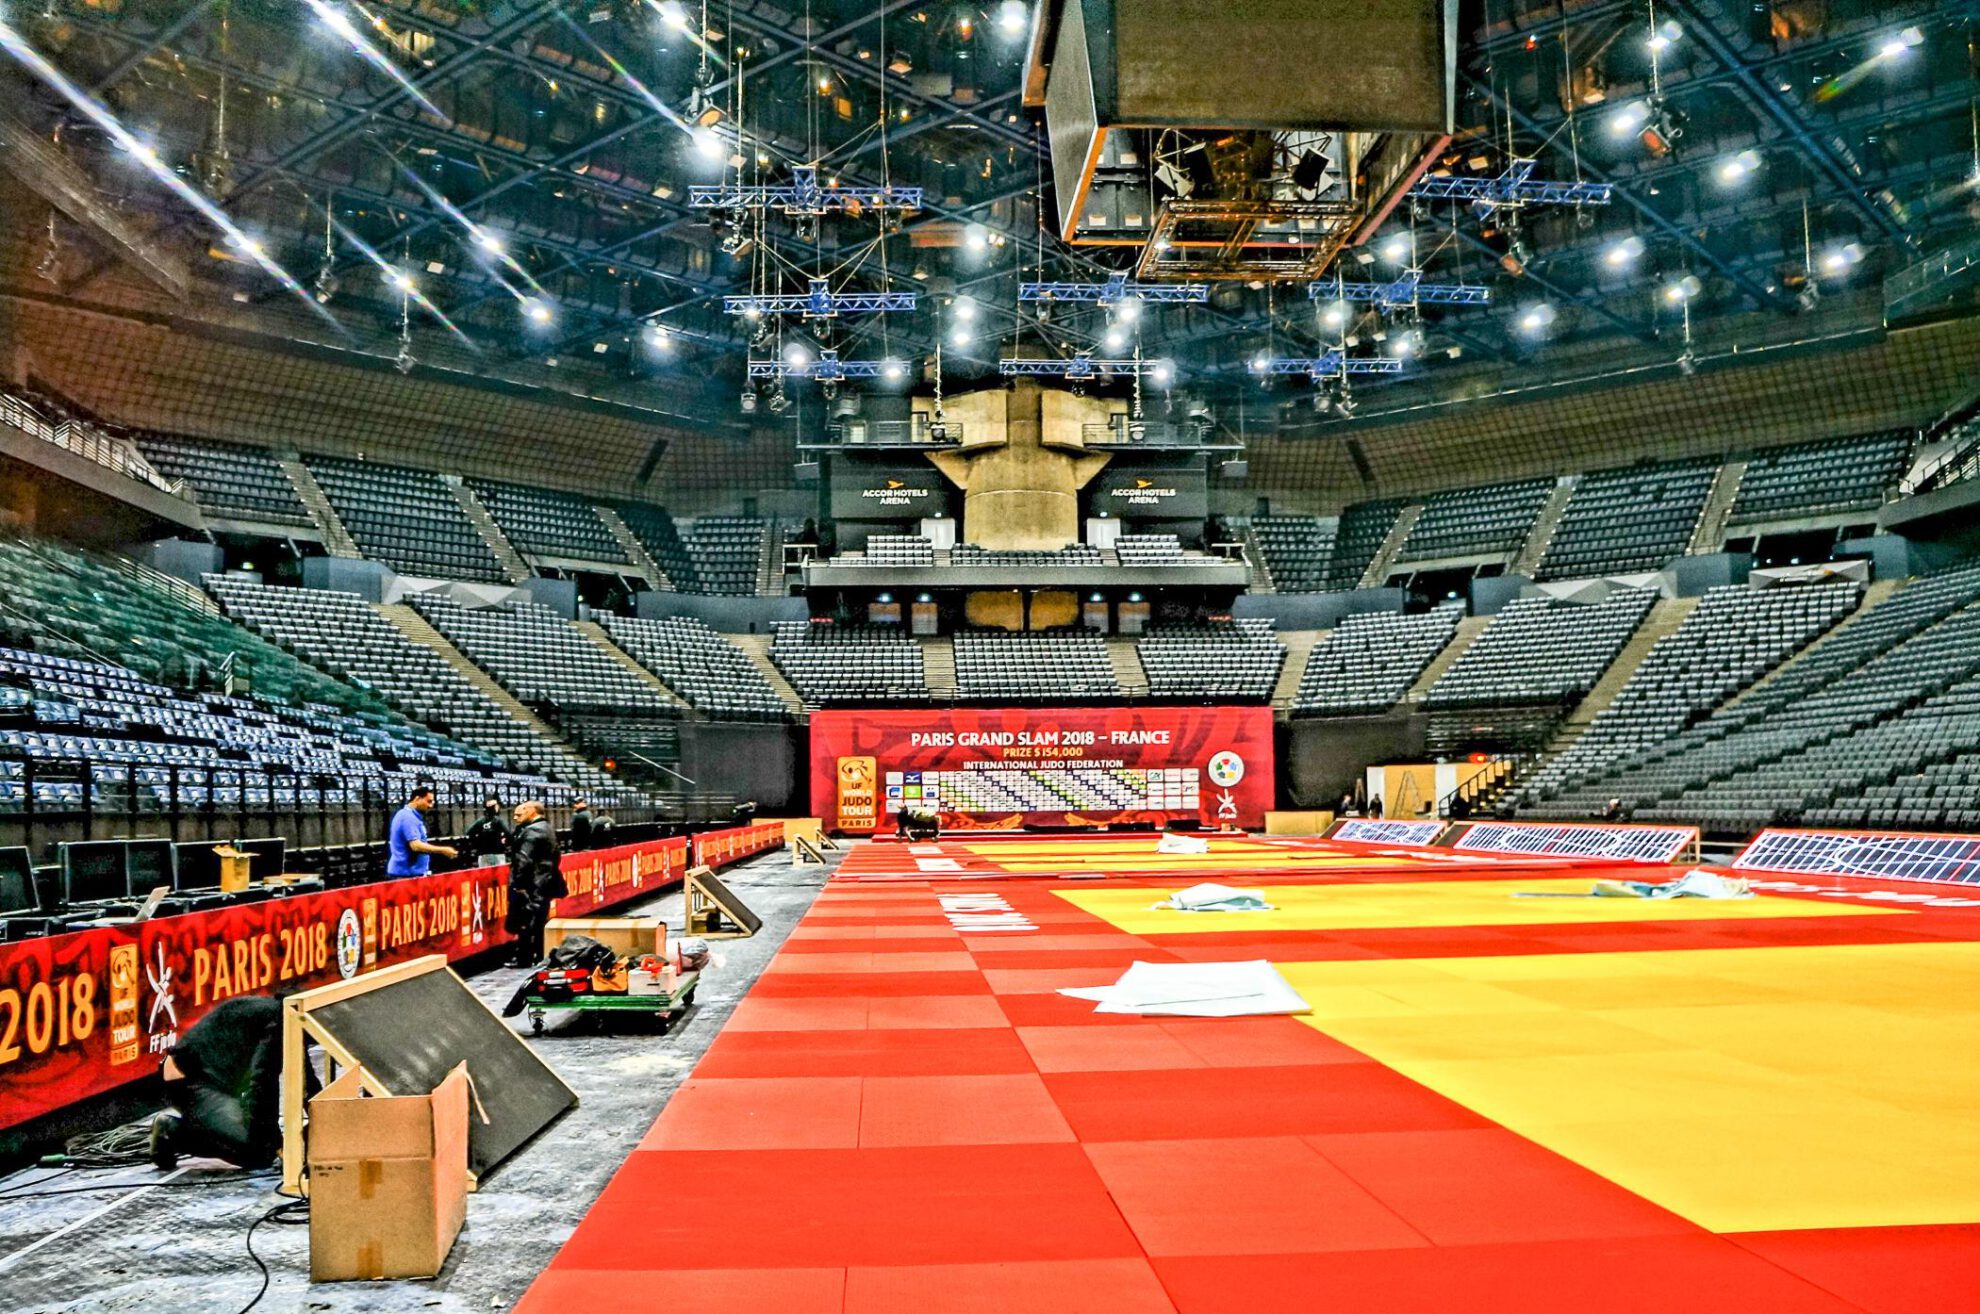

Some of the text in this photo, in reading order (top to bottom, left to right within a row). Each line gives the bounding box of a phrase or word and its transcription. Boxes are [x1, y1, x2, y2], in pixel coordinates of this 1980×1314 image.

[879, 497, 911, 505] ARENA
[1127, 496, 1159, 504] ARENA
[911, 732, 955, 747] PARIS
[957, 732, 1014, 747] GRAND
[1017, 731, 1059, 746] SLAM
[1061, 731, 1096, 746] 2018
[1110, 730, 1170, 745] FRANCE
[1003, 747, 1032, 758] PRIZE
[963, 759, 1124, 770] INTERNATIONAL JUDO FEDERATION
[842, 789, 873, 797] WORLD
[842, 796, 873, 806] JUDO
[842, 805, 873, 816] TOUR
[841, 818, 873, 827] PARIS
[487, 885, 508, 921] PAR
[381, 900, 425, 951] PARIS
[429, 894, 458, 937] 2018
[193, 933, 273, 1007] PARIS
[280, 921, 327, 980] 2018
[0, 971, 95, 1065] 2018
[112, 1024, 136, 1045] TOUR
